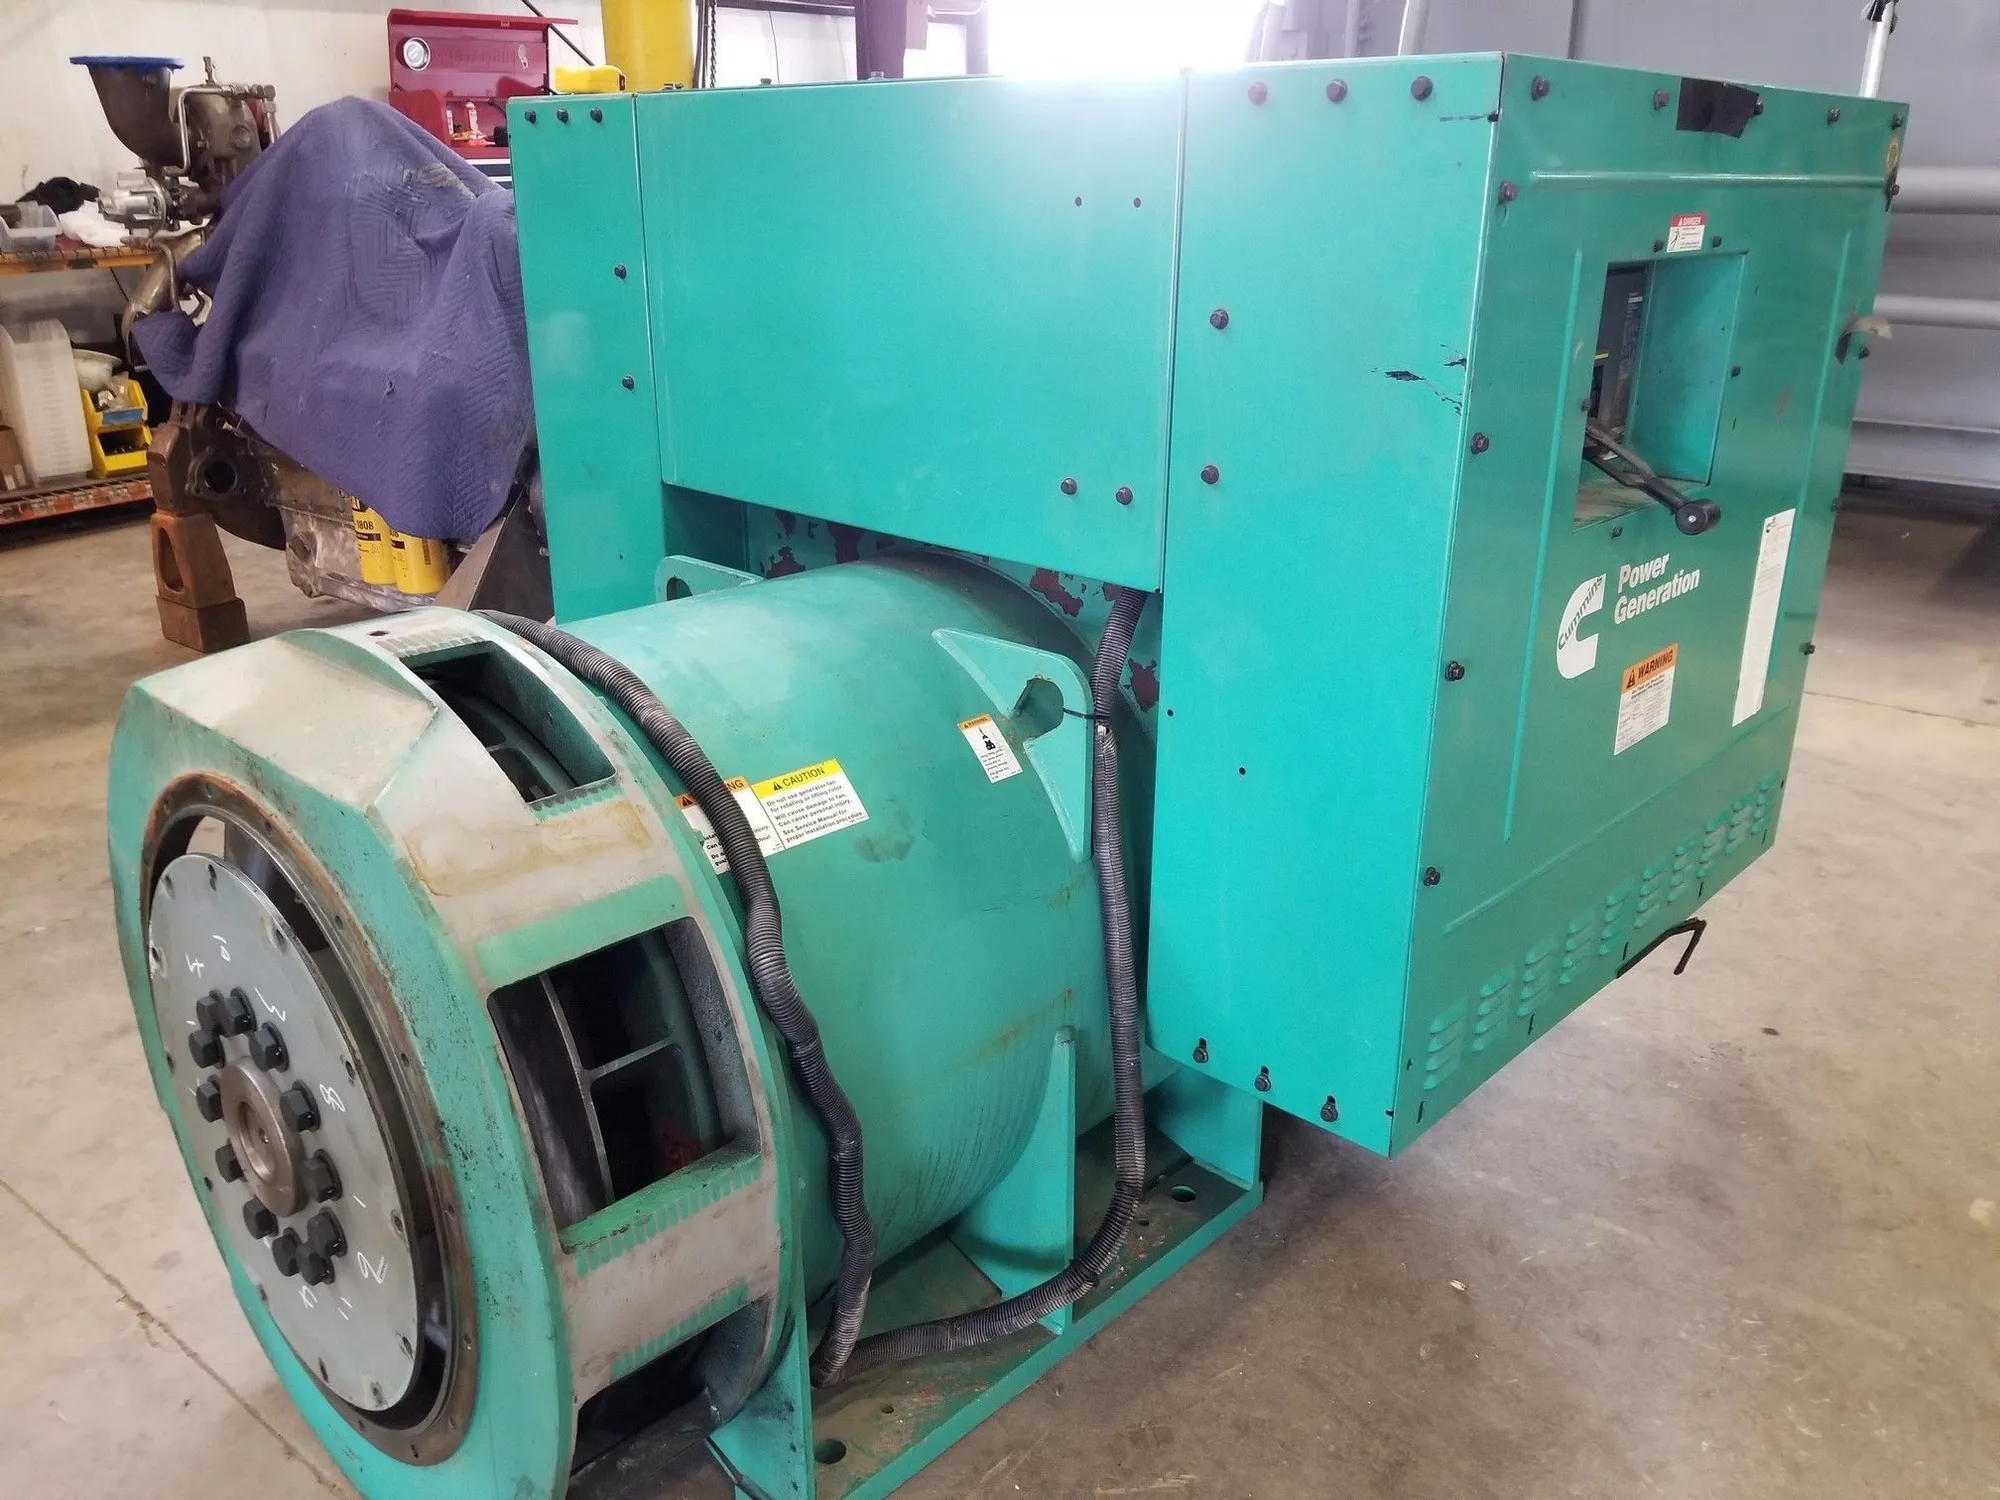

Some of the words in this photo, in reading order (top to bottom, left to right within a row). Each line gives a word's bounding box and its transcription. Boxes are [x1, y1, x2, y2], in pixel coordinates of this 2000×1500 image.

[1617, 552, 1670, 594] Power
[1613, 568, 1701, 625] Generation
[1558, 576, 1603, 650] Cummins
[1638, 650, 1673, 679] WARNING
[782, 766, 825, 787] CAUTION
[780, 799, 804, 810] rotating
[810, 790, 829, 799] lifting
[799, 783, 826, 797] generator
[787, 807, 805, 816] cause
[805, 800, 828, 810] damage
[791, 813, 809, 823] cause
[809, 803, 834, 817] personal
[795, 820, 817, 831] Service
[817, 811, 839, 822] Manual
[786, 831, 805, 843] proper
[805, 820, 836, 835] installation
[706, 842, 718, 850] Can
